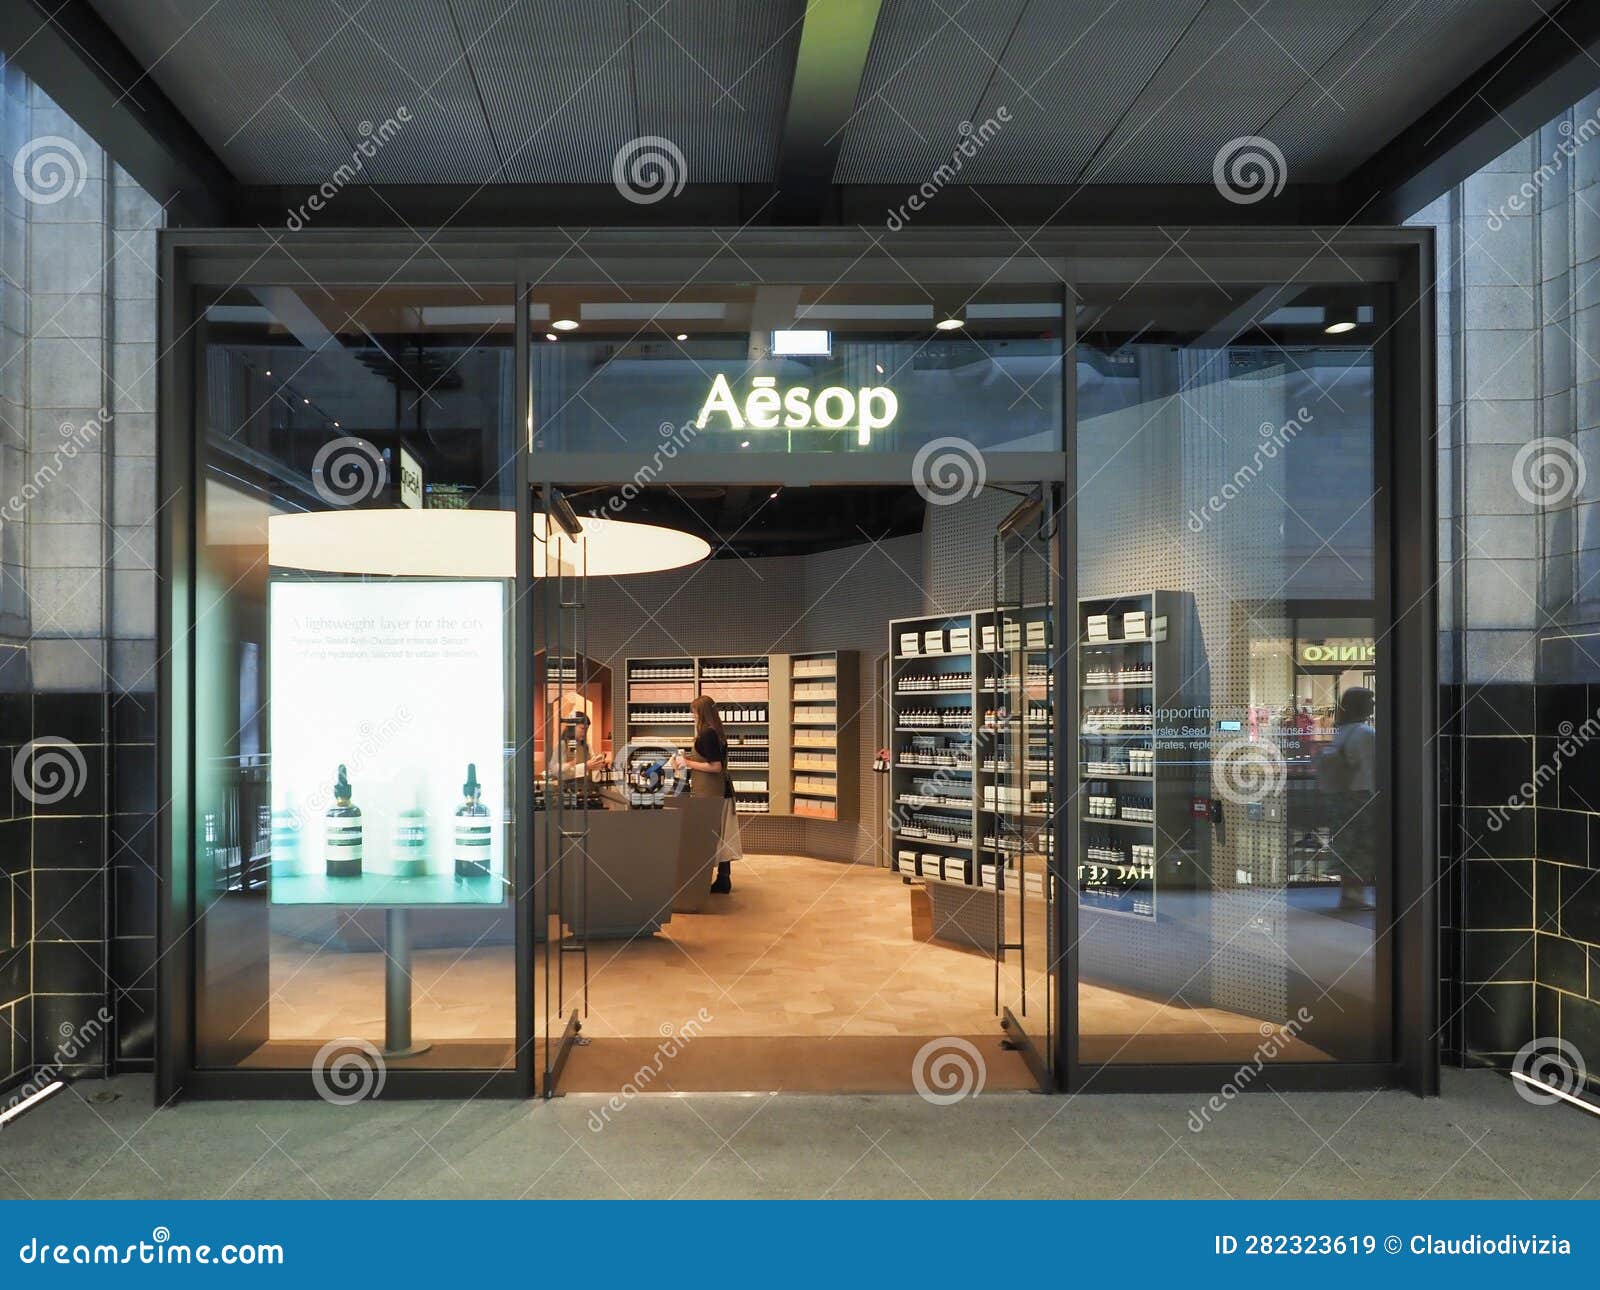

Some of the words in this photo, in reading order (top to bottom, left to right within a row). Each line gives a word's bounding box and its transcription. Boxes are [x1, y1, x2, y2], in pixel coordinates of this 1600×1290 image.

[696, 373, 898, 446] Aēsop
[305, 615, 376, 632] lightweight
[380, 615, 410, 632] layer
[415, 615, 433, 630] for
[436, 615, 458, 630] the
[1181, 726, 1206, 736] Seed
